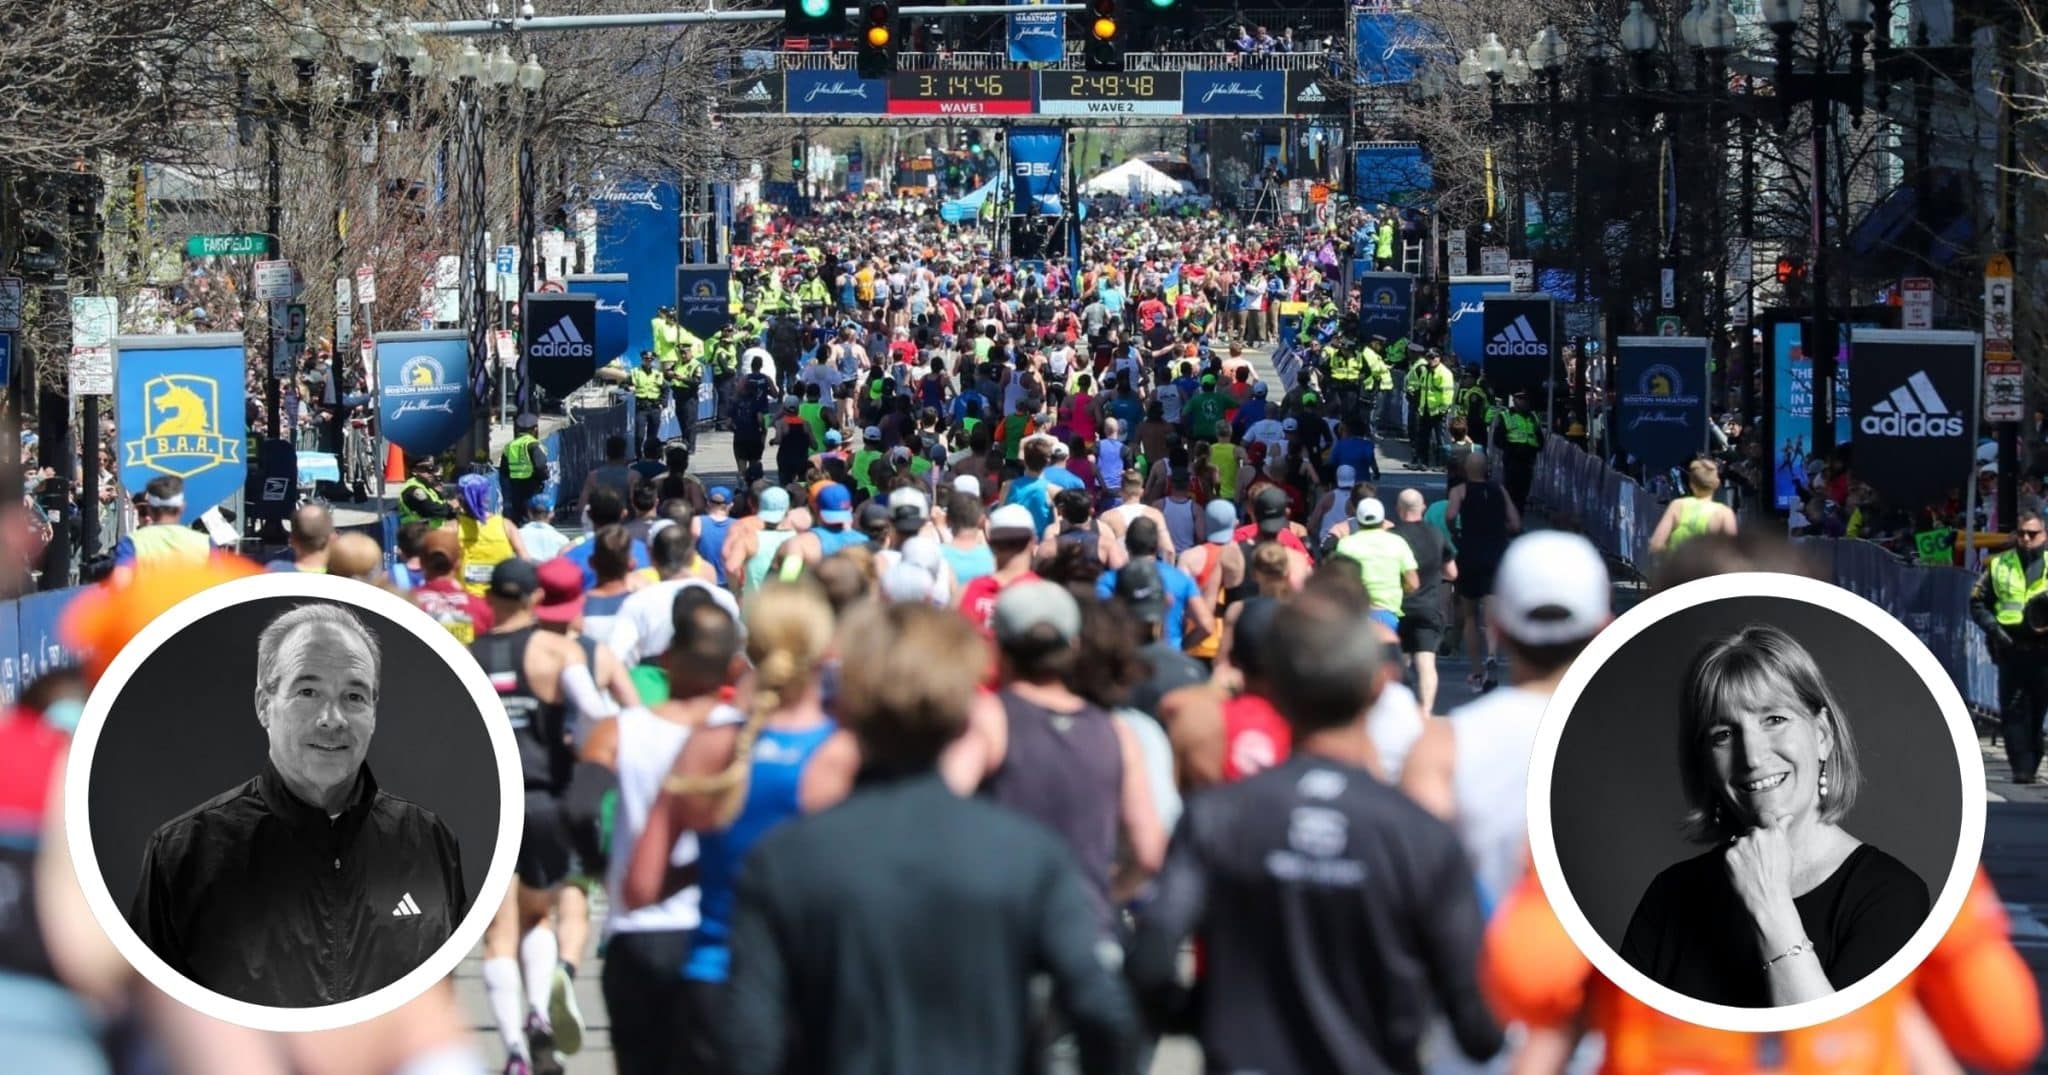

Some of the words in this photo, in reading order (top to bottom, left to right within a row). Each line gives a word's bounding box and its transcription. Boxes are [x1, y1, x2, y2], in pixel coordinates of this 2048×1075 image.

[1070, 75, 1154, 96] 2:49:48
[940, 103, 977, 113] WAVE
[978, 103, 984, 112] 1
[1088, 103, 1126, 112] WAVE
[1127, 103, 1135, 112] 2
[203, 237, 252, 252] FAIRFIELD
[530, 342, 593, 357] adidas
[1486, 340, 1548, 356] adidas
[1861, 412, 1964, 438] adidas
[157, 436, 214, 453] B.A.A.
